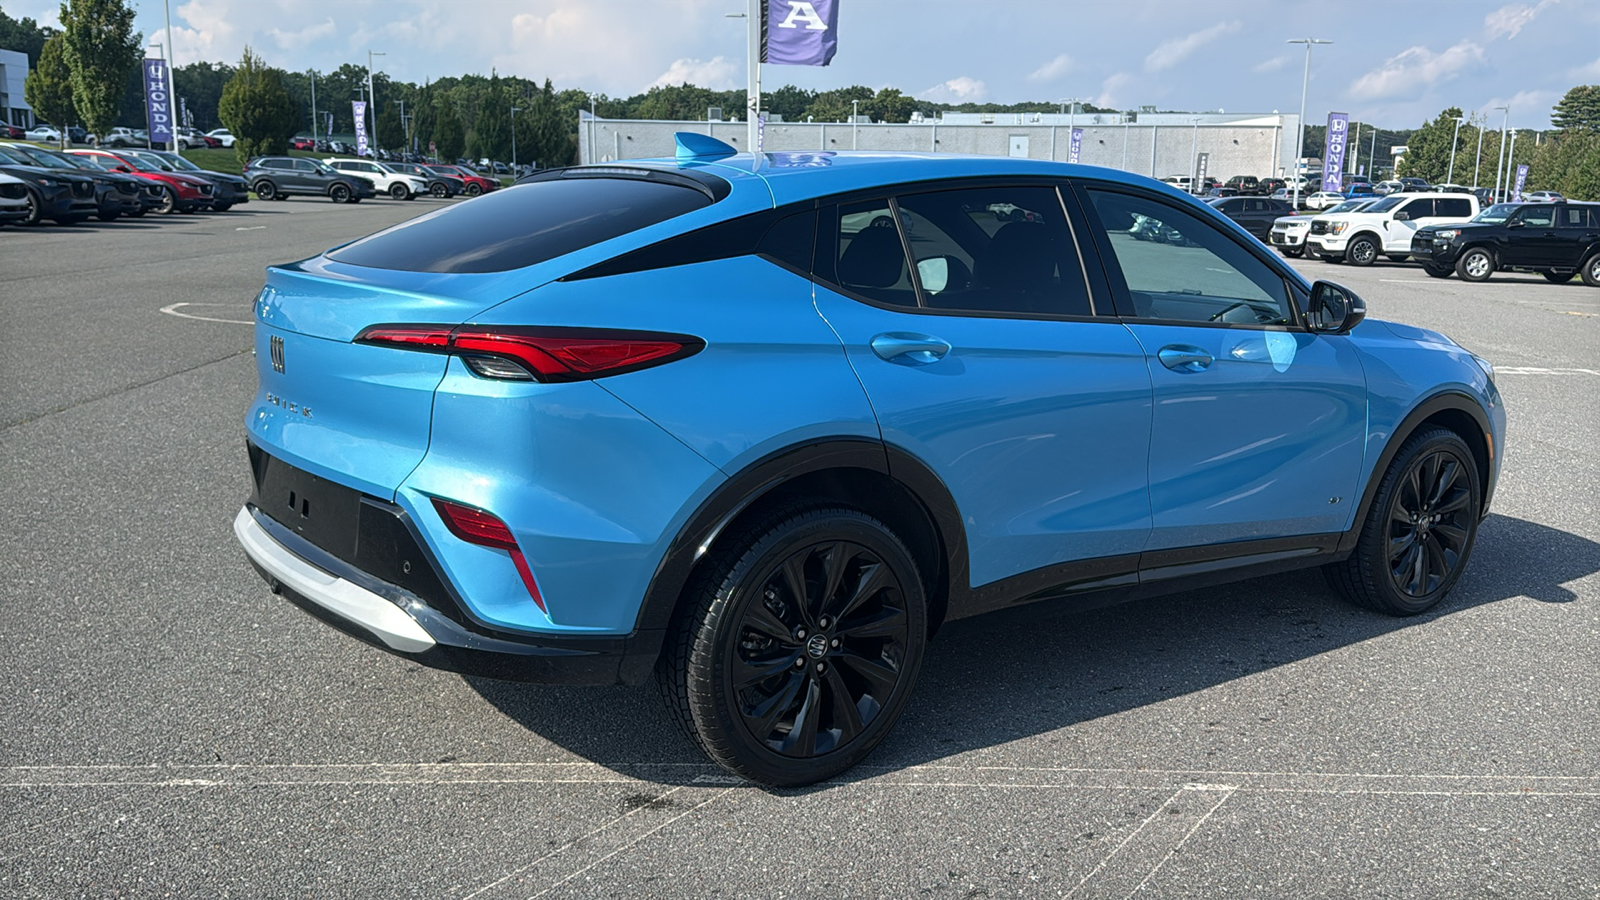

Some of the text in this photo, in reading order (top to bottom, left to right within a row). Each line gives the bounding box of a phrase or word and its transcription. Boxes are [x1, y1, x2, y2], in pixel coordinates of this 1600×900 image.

[778, 0, 829, 30] A
[149, 82, 170, 134] HONDA
[1070, 140, 1080, 164] HOND
[1326, 134, 1345, 184] HONDA
